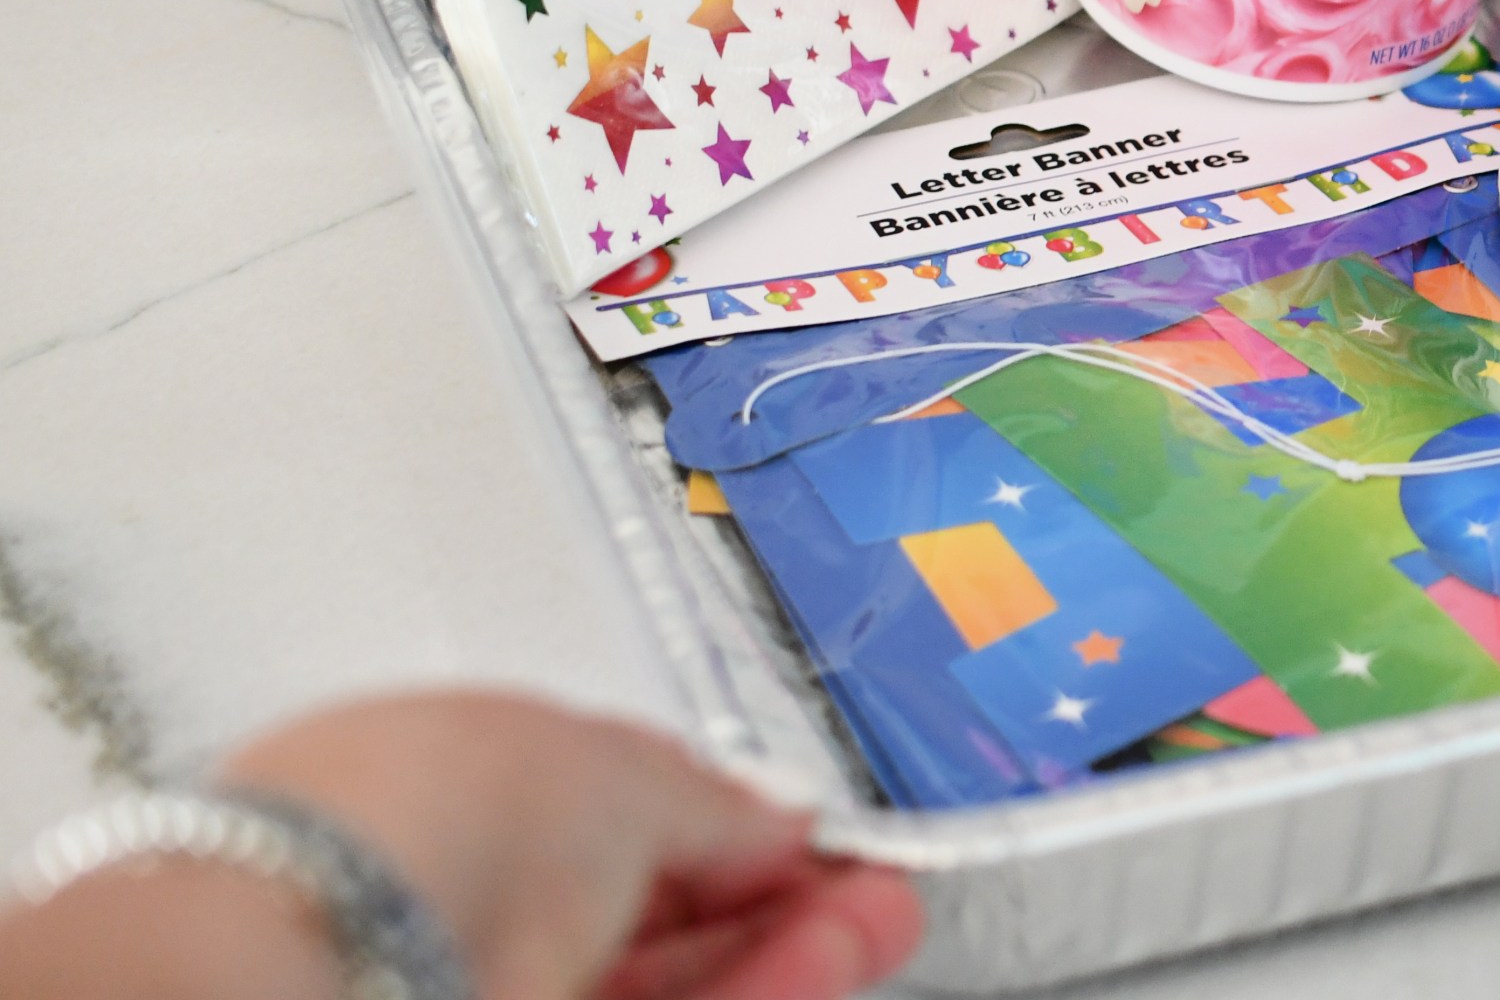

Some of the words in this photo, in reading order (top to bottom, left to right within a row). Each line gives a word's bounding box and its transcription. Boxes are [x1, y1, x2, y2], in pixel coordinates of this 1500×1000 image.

[1370, 46, 1395, 65] NET
[1398, 40, 1417, 60] WT
[869, 185, 1065, 238] Bannière
[1074, 177, 1103, 196] à
[1107, 149, 1250, 189] lettres
[891, 161, 1022, 200] Letter
[1033, 128, 1182, 173] Banner
[1027, 212, 1037, 222] 7
[1042, 210, 1055, 219] ft
[1059, 201, 1095, 217] (213
[1098, 195, 1130, 208] cm)
[620, 250, 957, 336] HAPPY
